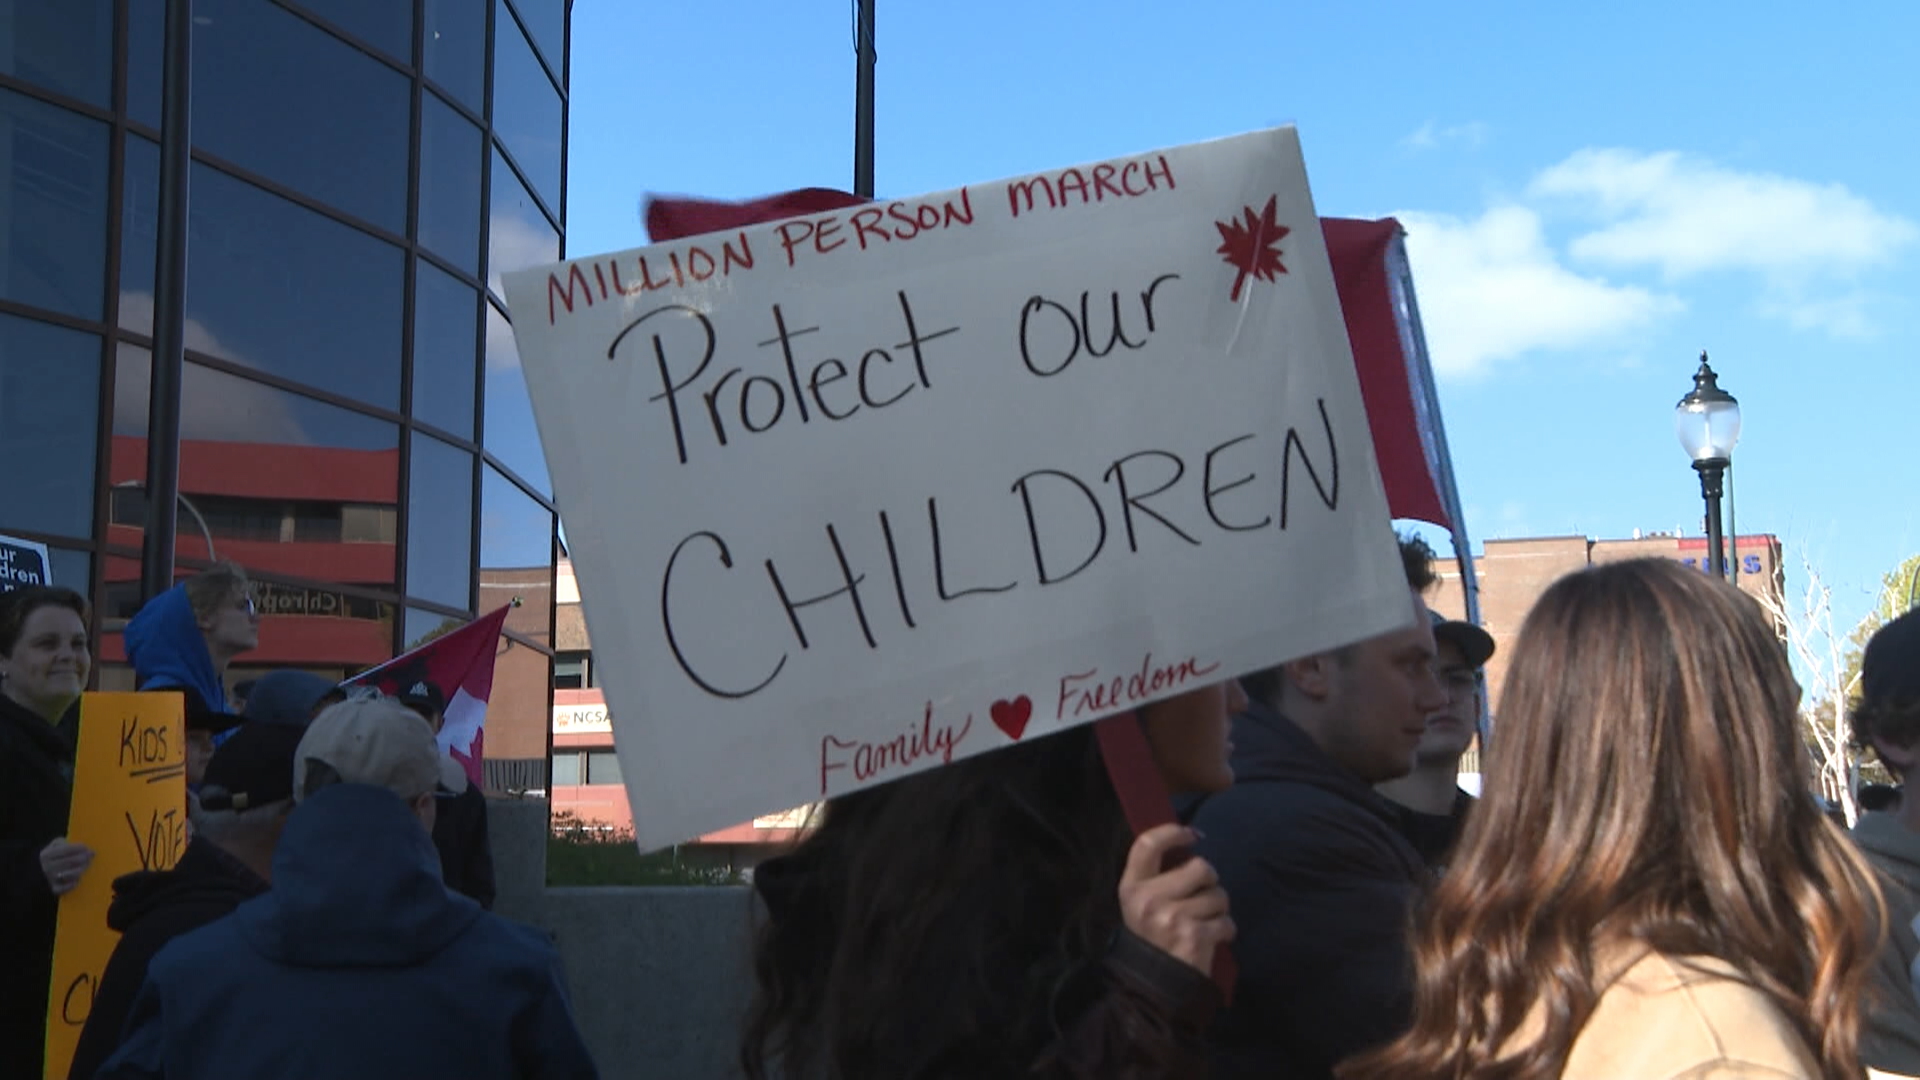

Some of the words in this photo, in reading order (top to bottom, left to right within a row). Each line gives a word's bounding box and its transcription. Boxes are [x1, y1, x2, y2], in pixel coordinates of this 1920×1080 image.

[547, 225, 754, 325] MILLION
[780, 188, 975, 266] PERSON
[1007, 154, 1177, 218] MARCH
[608, 291, 959, 464] Protect
[662, 398, 1338, 699] CHILDREN
[119, 716, 168, 767] KIDS
[821, 701, 972, 796] Family
[1057, 653, 1220, 720] Freedom
[125, 809, 184, 872] VOTE
